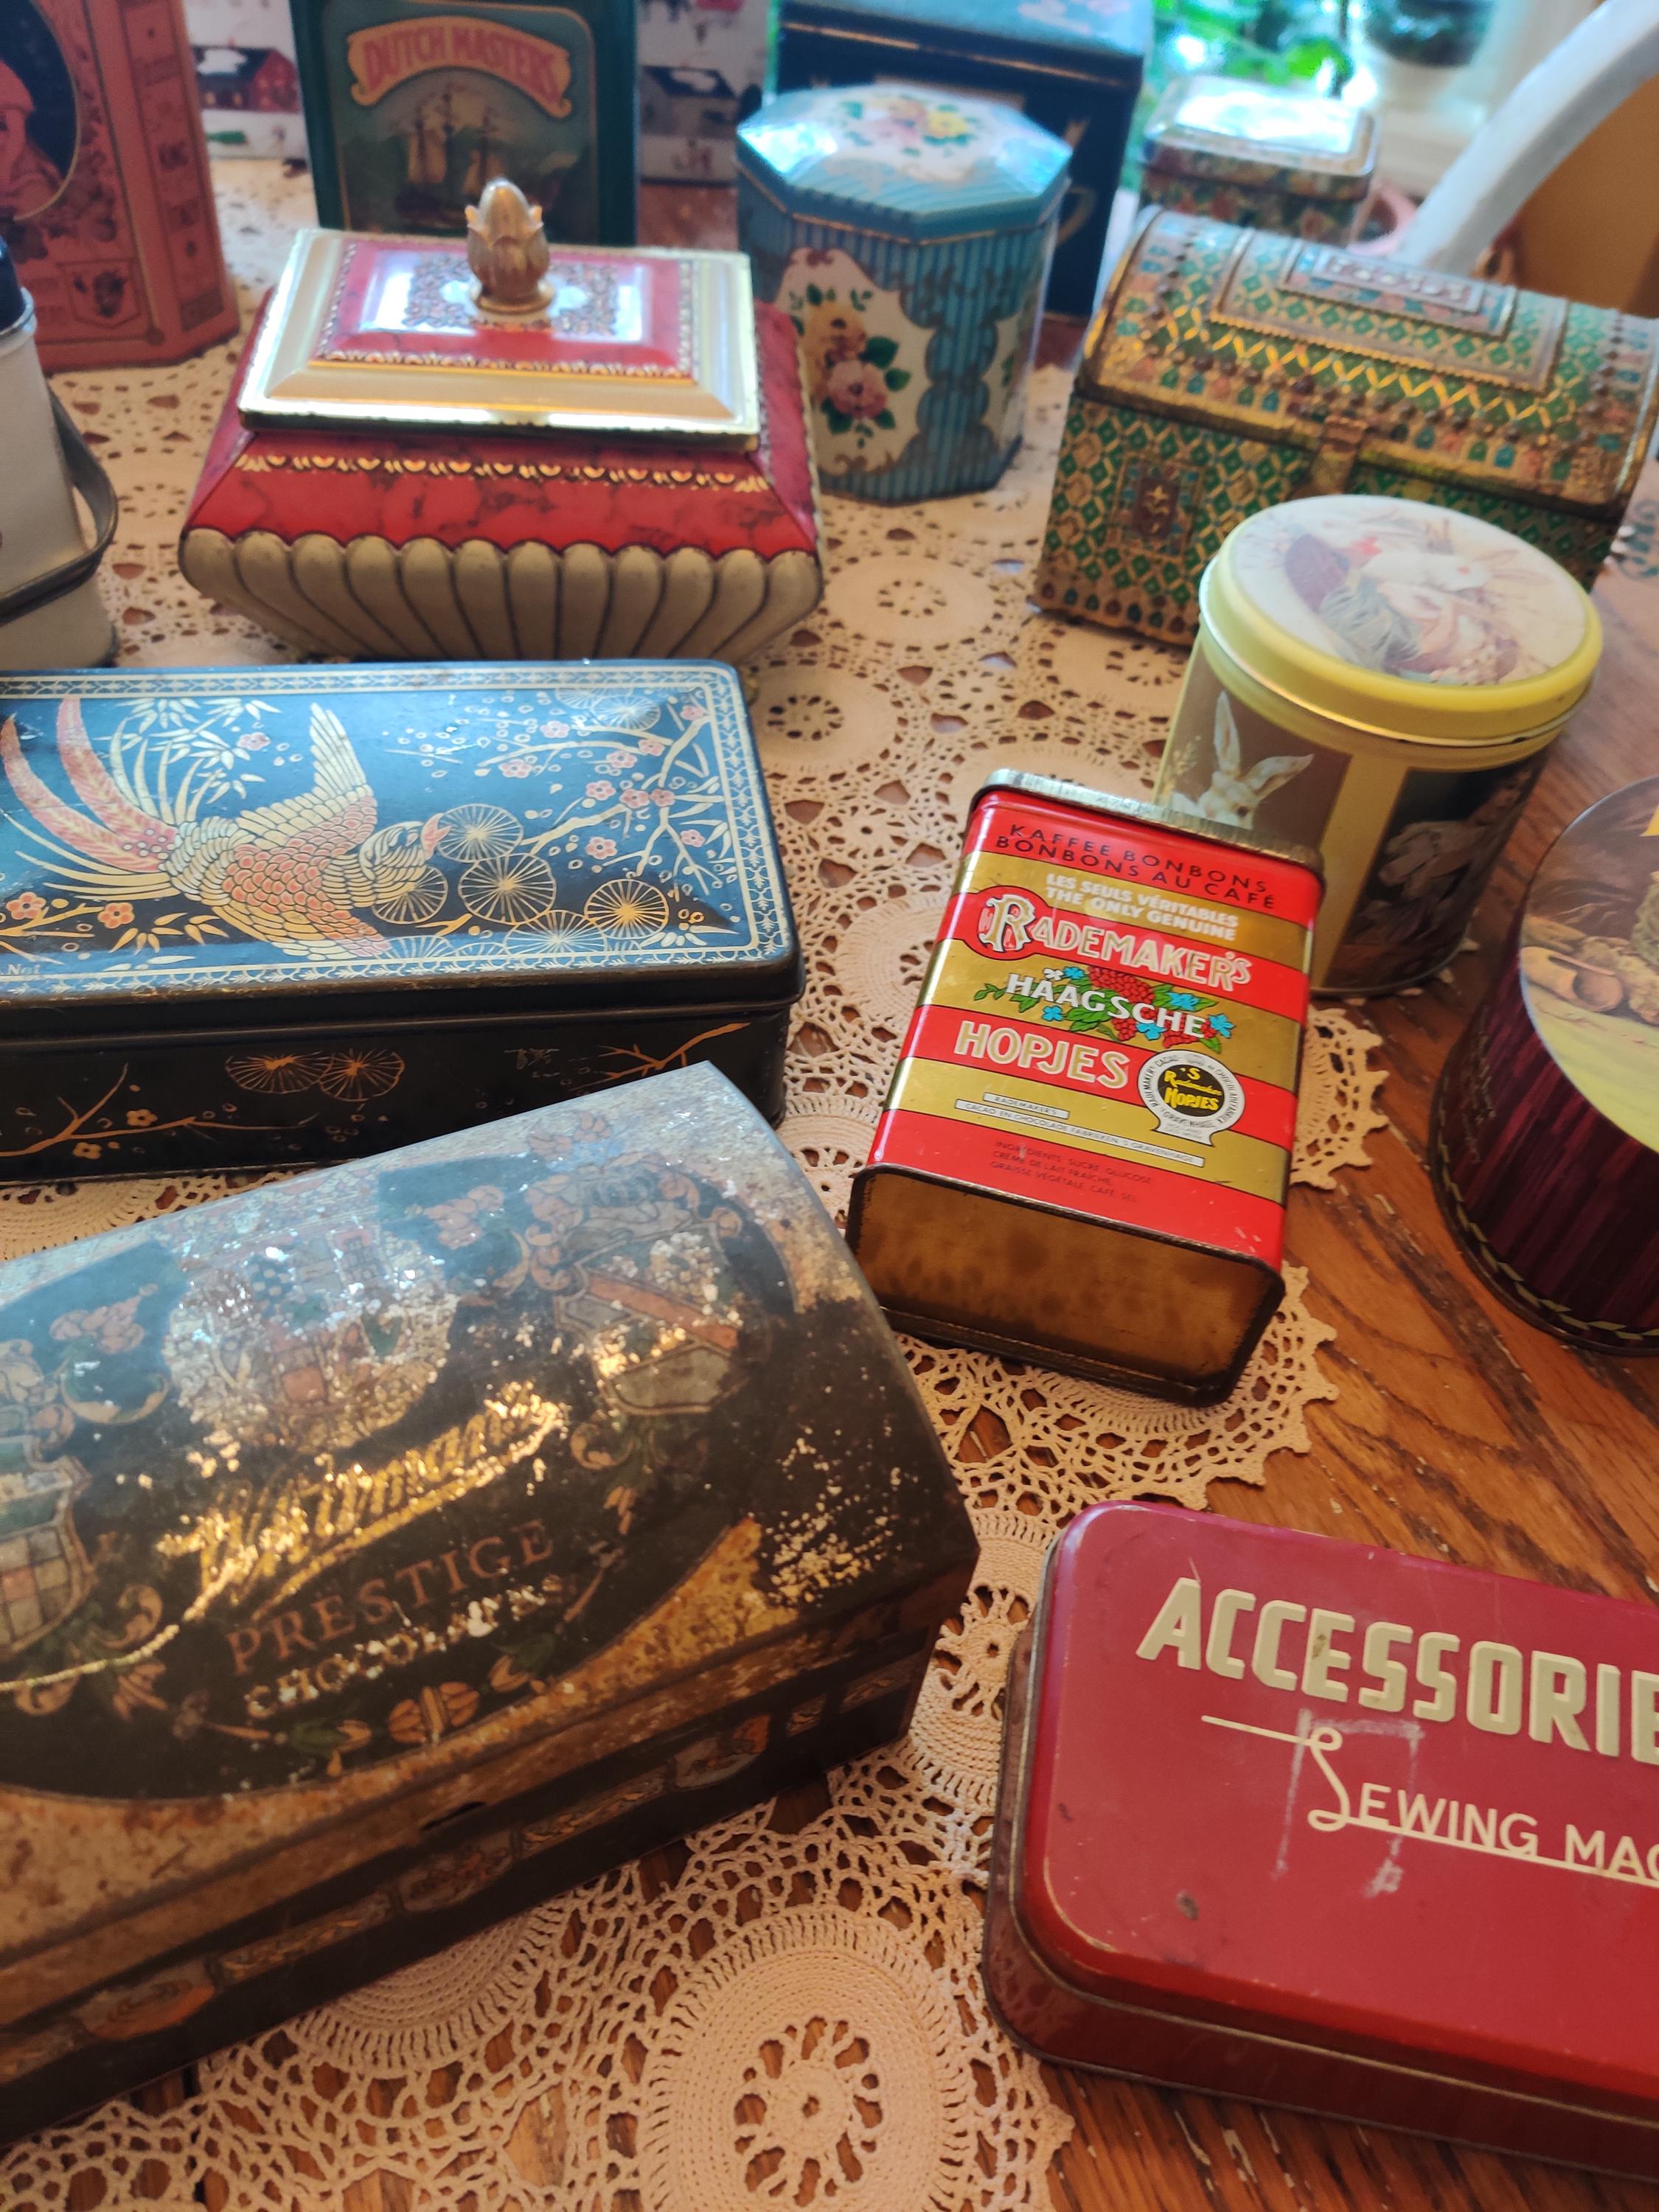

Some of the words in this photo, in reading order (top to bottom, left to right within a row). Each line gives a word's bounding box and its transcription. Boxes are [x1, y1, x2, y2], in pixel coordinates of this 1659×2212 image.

[362, 26, 444, 91] DUTCH
[451, 26, 563, 104] MASTERS
[995, 835, 1140, 877] BONBONS
[1152, 870, 1191, 890] AU
[1204, 883, 1275, 911] CAFÉ
[1009, 824, 1110, 857] KAFFEE
[1123, 849, 1267, 894] BONBONS
[1045, 886, 1085, 905] THE
[1089, 896, 1146, 919] ONLY
[1146, 909, 1237, 942] GENUINE
[1046, 872, 1077, 890] LES
[1080, 880, 1133, 903] SEULS
[1137, 893, 1239, 928] VÉRITABLES
[978, 893, 1253, 992] RADEMAKER'S
[1005, 973, 1207, 1039] HAAGSCHE
[953, 1020, 1131, 1090] HOPJES
[1164, 1087, 1220, 1111] HOPJES
[226, 1519, 554, 1676] PRESTIGE
[1307, 1726, 1539, 1857] SEWING
